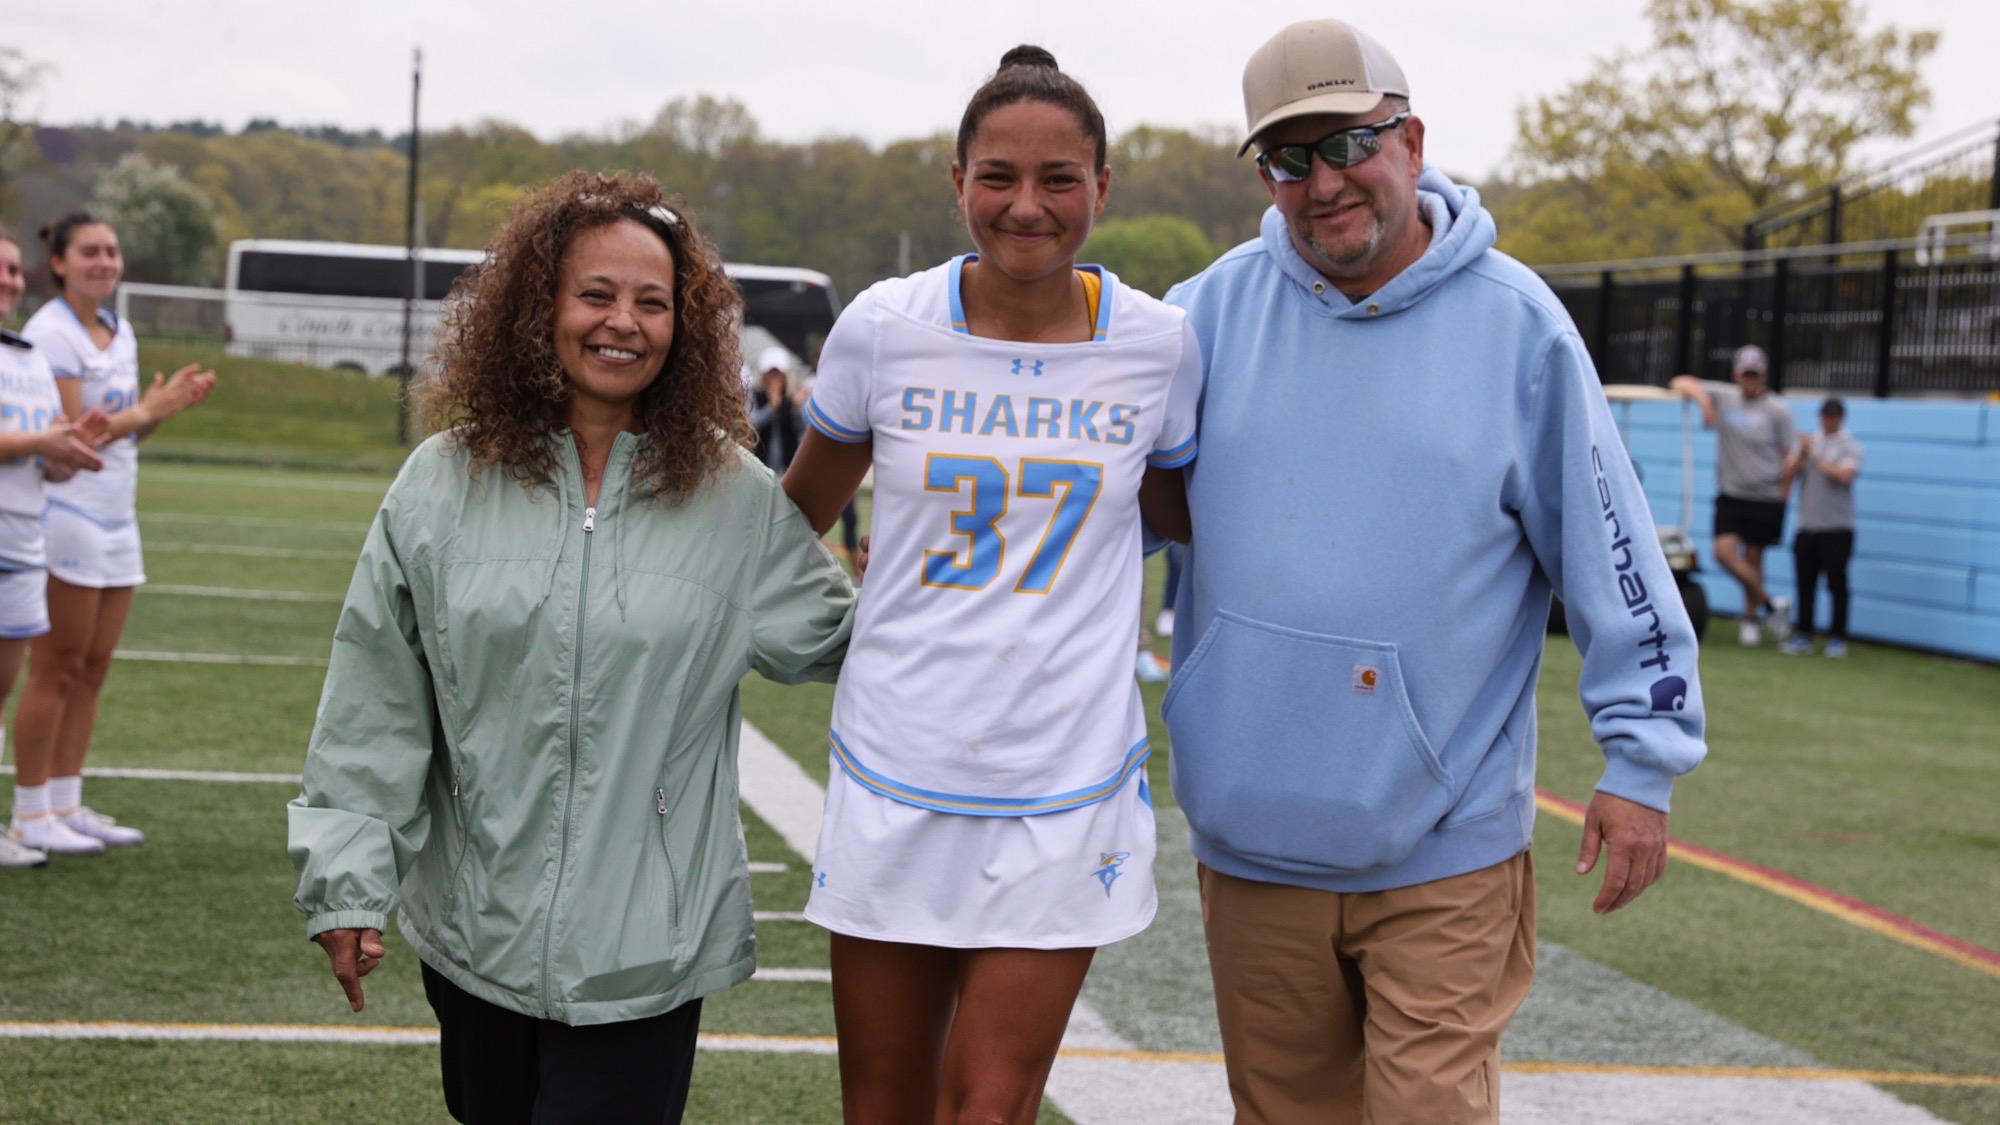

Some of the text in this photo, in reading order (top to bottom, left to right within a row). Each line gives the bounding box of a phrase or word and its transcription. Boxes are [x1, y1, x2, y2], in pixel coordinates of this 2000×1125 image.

[1307, 79, 1355, 91] OAKLEY
[901, 386, 1140, 445] SHARKS
[921, 452, 1104, 595] 37
[1591, 444, 1671, 672] carhartt
